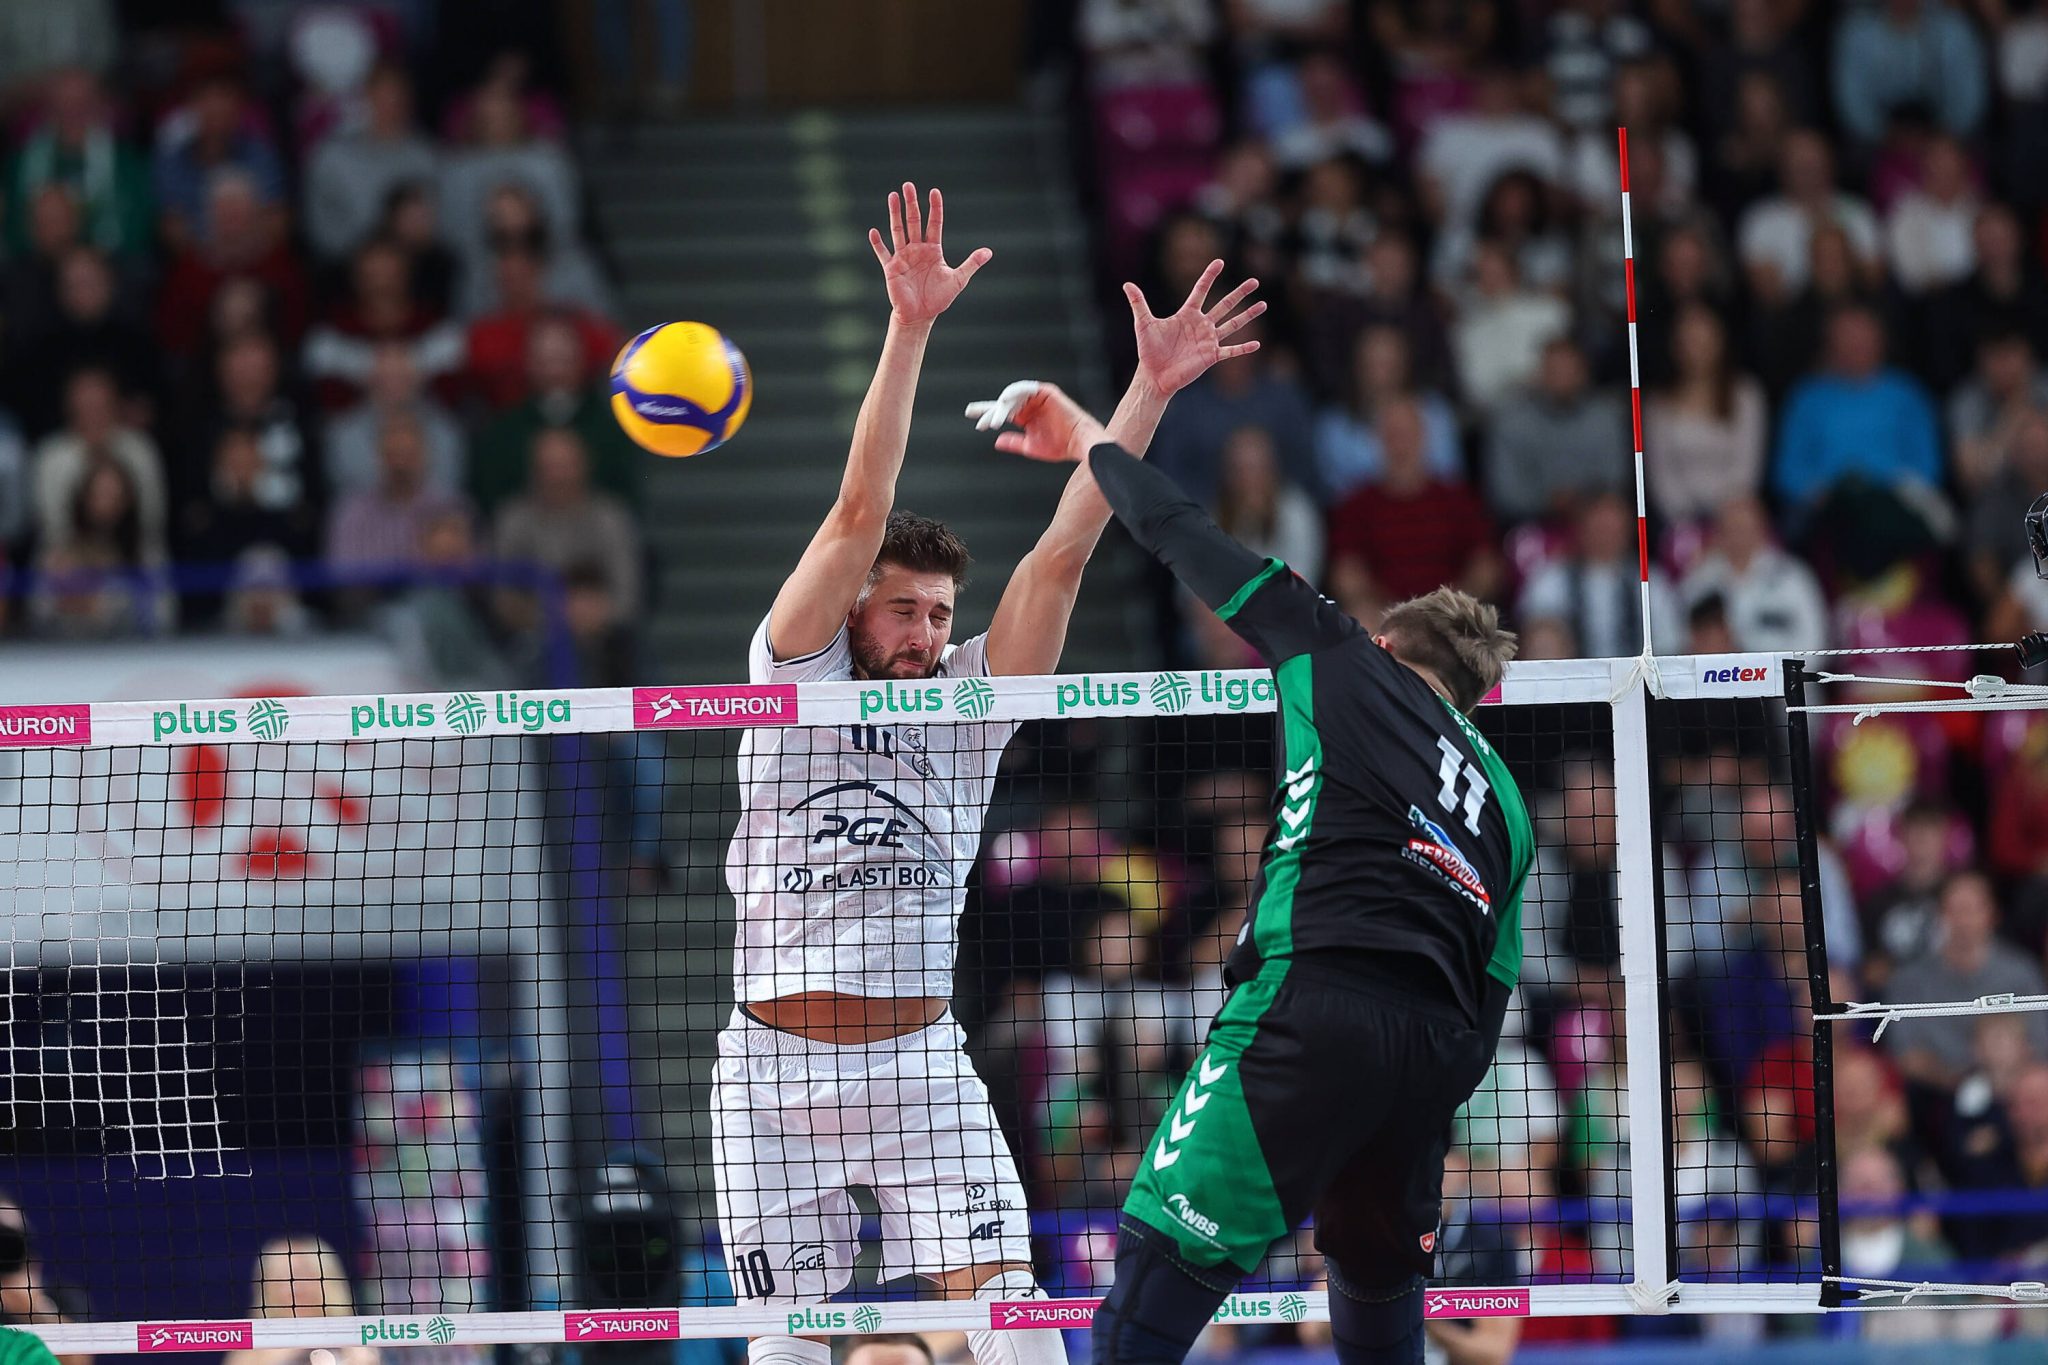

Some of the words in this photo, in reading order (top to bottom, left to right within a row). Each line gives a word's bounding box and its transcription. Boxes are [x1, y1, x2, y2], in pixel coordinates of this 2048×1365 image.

[1703, 666, 1767, 684] netex
[685, 695, 783, 717] TAURON
[860, 681, 943, 720] plus
[1056, 676, 1140, 714] plus
[1200, 671, 1275, 710] liga
[153, 703, 238, 742] plus
[351, 697, 436, 736] plus
[495, 693, 571, 732] liga
[1437, 734, 1490, 837] 11
[813, 814, 908, 849] PGE
[822, 867, 892, 889] PLAST
[898, 867, 940, 887] BOX
[949, 1202, 986, 1219] PLAST
[989, 1199, 1014, 1211] BOX
[1181, 1205, 1220, 1237] WBS
[971, 1220, 1005, 1241] 4F
[736, 1248, 776, 1300] 10
[795, 1252, 825, 1276] PGE
[1026, 1307, 1094, 1321] TAURON
[1213, 1296, 1272, 1323] plus
[1452, 1296, 1519, 1310] TAURON
[361, 1318, 420, 1345] plus
[601, 1319, 669, 1333] TAURON
[787, 1307, 846, 1334] plus
[173, 1330, 242, 1344] TAURON
